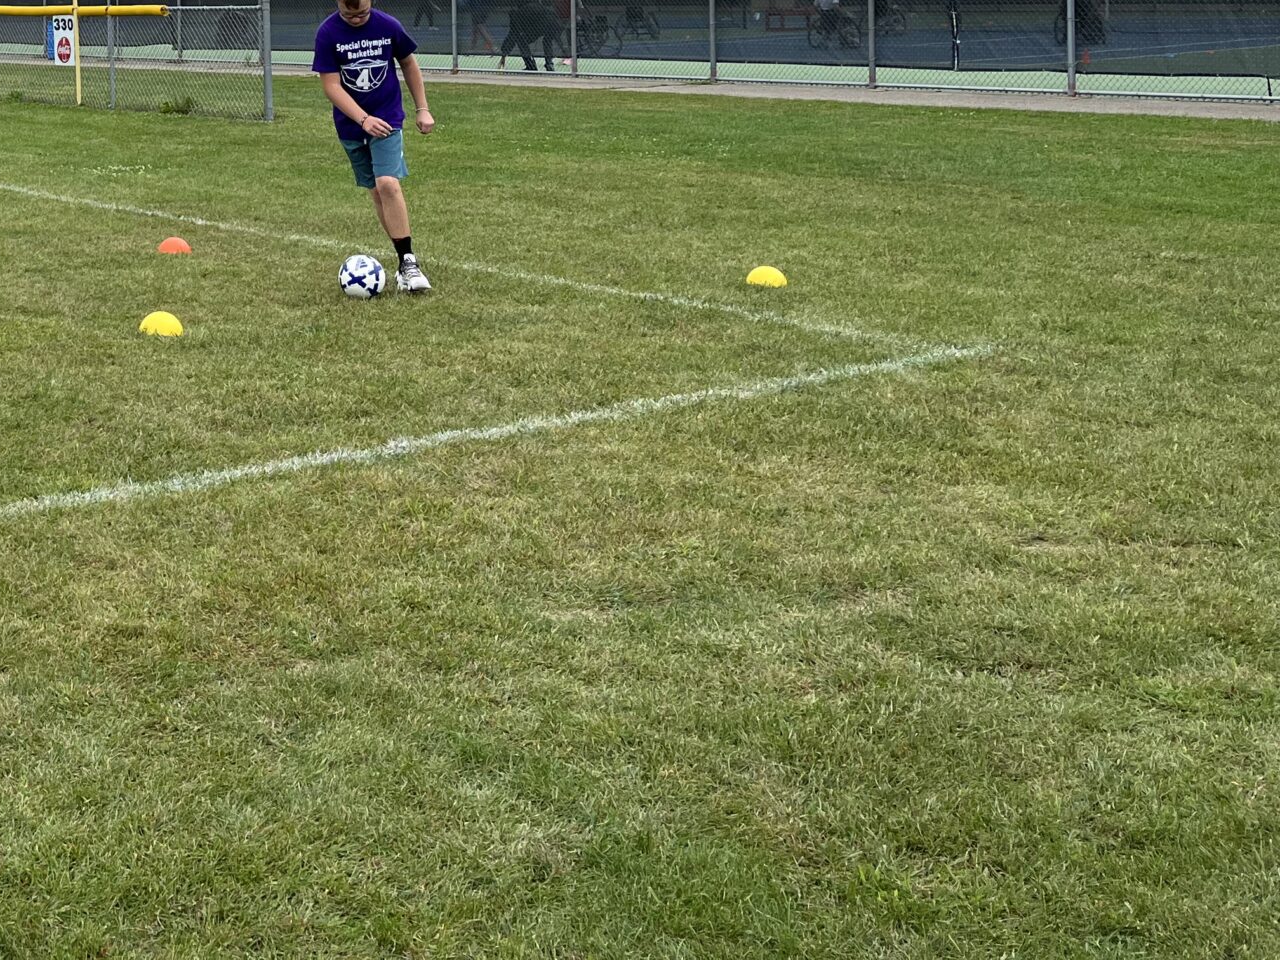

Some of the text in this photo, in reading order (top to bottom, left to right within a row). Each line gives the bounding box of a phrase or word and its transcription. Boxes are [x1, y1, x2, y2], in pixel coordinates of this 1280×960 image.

[53, 18, 74, 31] 330
[336, 37, 391, 53] Special Olympics
[347, 47, 383, 59] Basketball
[355, 68, 371, 90] 4
